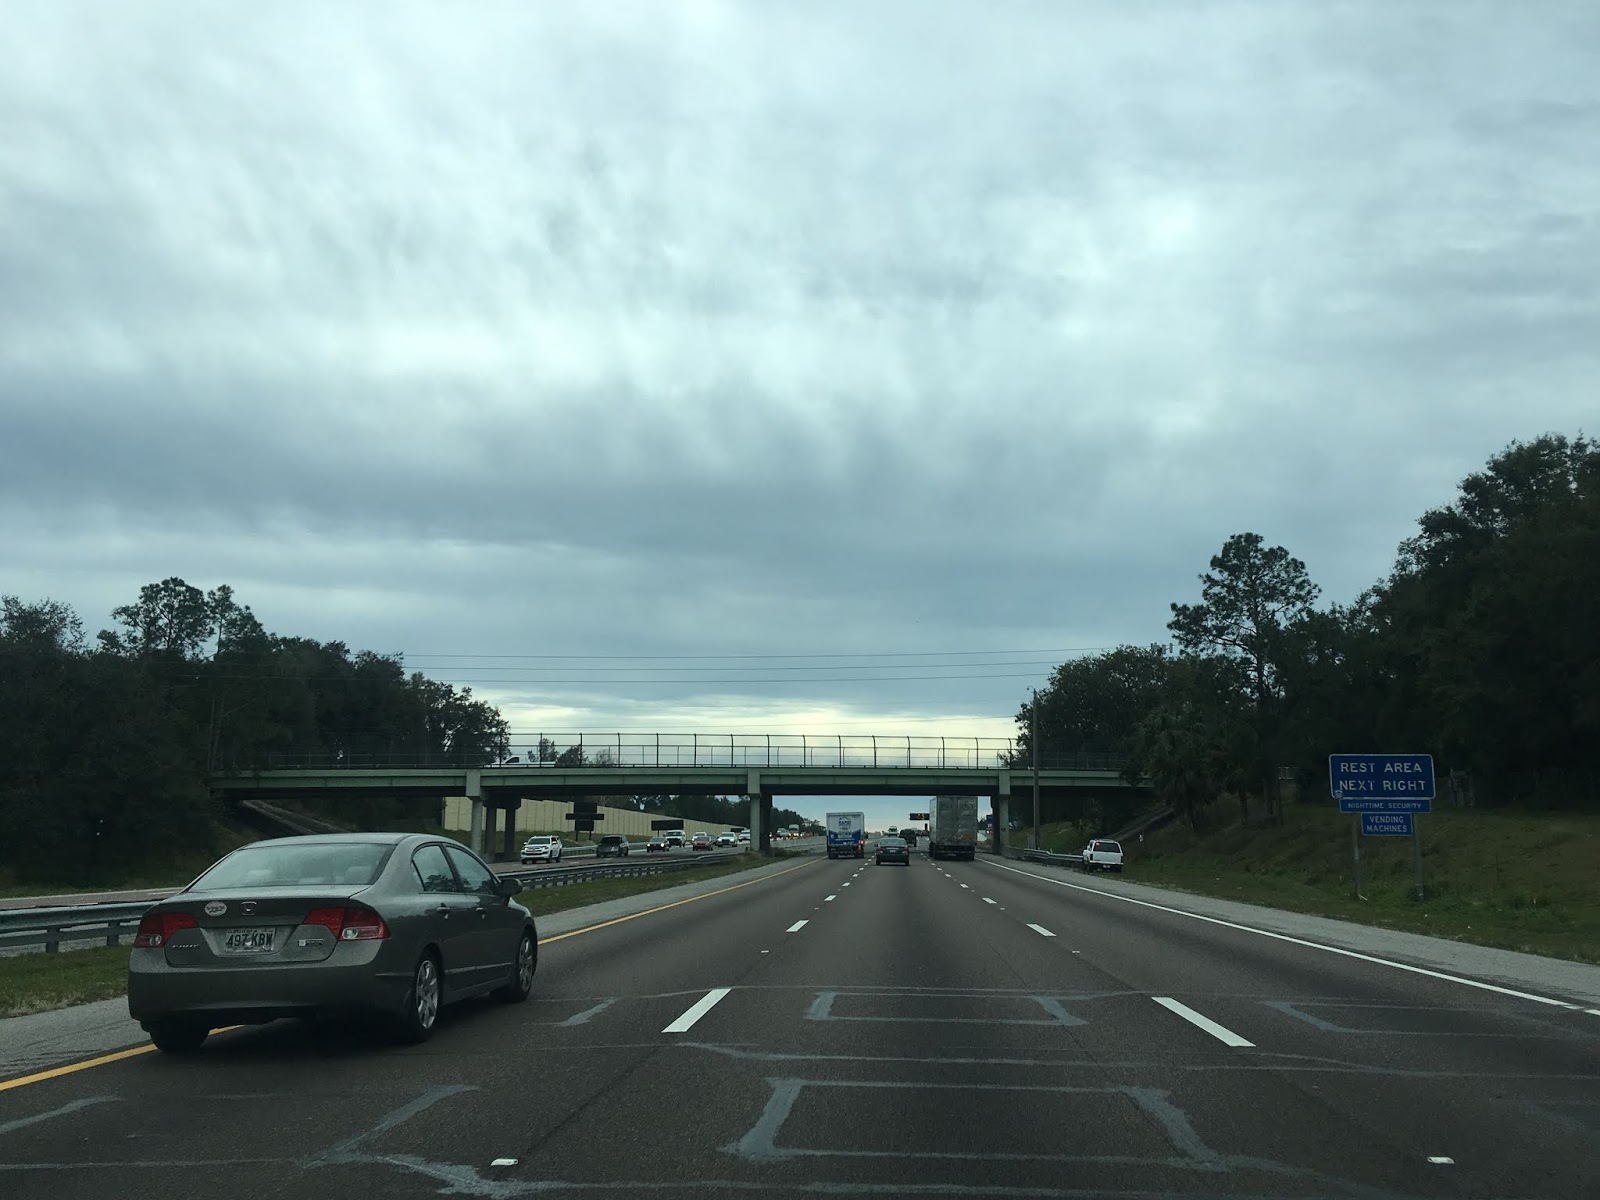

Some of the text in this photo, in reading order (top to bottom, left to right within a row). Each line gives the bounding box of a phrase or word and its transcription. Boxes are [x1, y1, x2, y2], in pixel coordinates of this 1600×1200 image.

[1340, 763, 1422, 772] REST AREA
[1339, 780, 1426, 791] NEXT RIGHT
